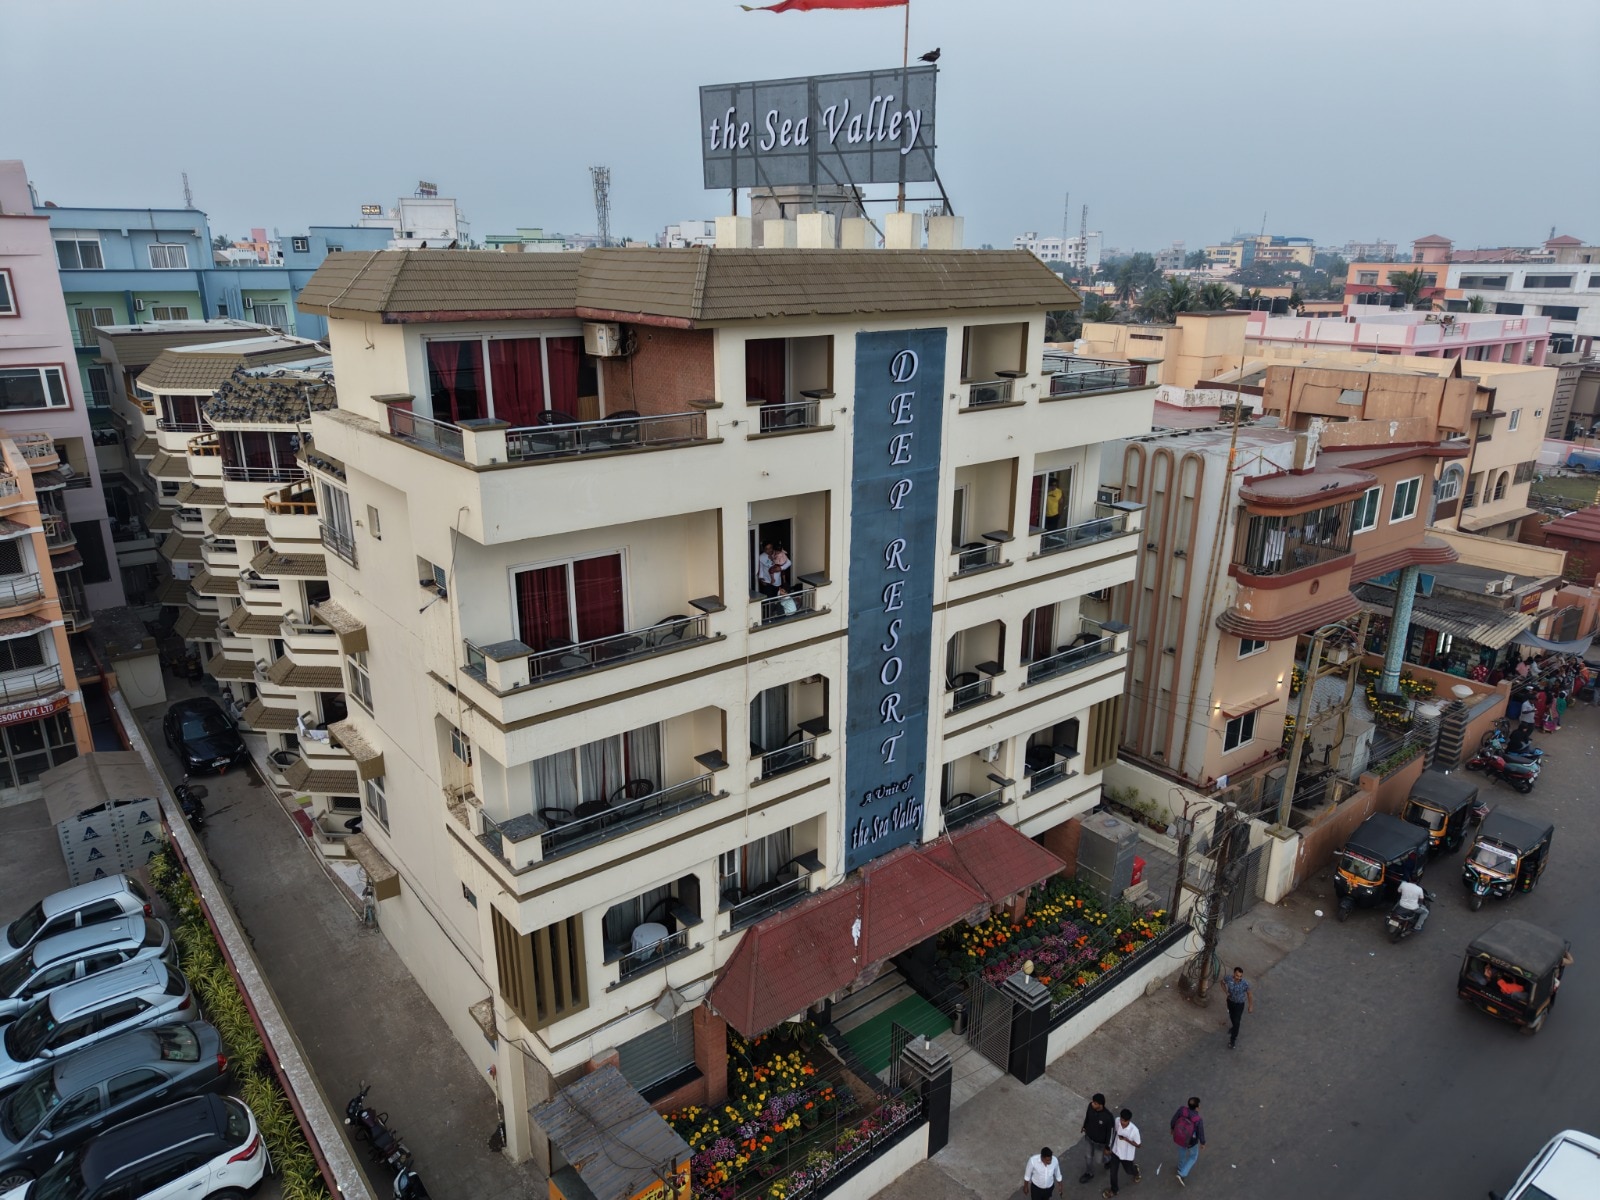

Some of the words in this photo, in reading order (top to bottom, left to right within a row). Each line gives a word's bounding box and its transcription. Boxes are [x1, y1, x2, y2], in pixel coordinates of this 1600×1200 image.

[709, 106, 750, 151] the
[760, 109, 809, 151] Sea
[822, 95, 922, 155] Valley
[889, 349, 919, 511] DEEP
[881, 538, 911, 765] RESORT
[0, 711, 22, 722] SORT
[23, 708, 40, 717] PVT.
[862, 792, 873, 807] A
[875, 784, 900, 799] Unit
[901, 775, 914, 792] of
[852, 818, 870, 850] the
[871, 816, 889, 844] Sea
[892, 796, 923, 831] Valley
